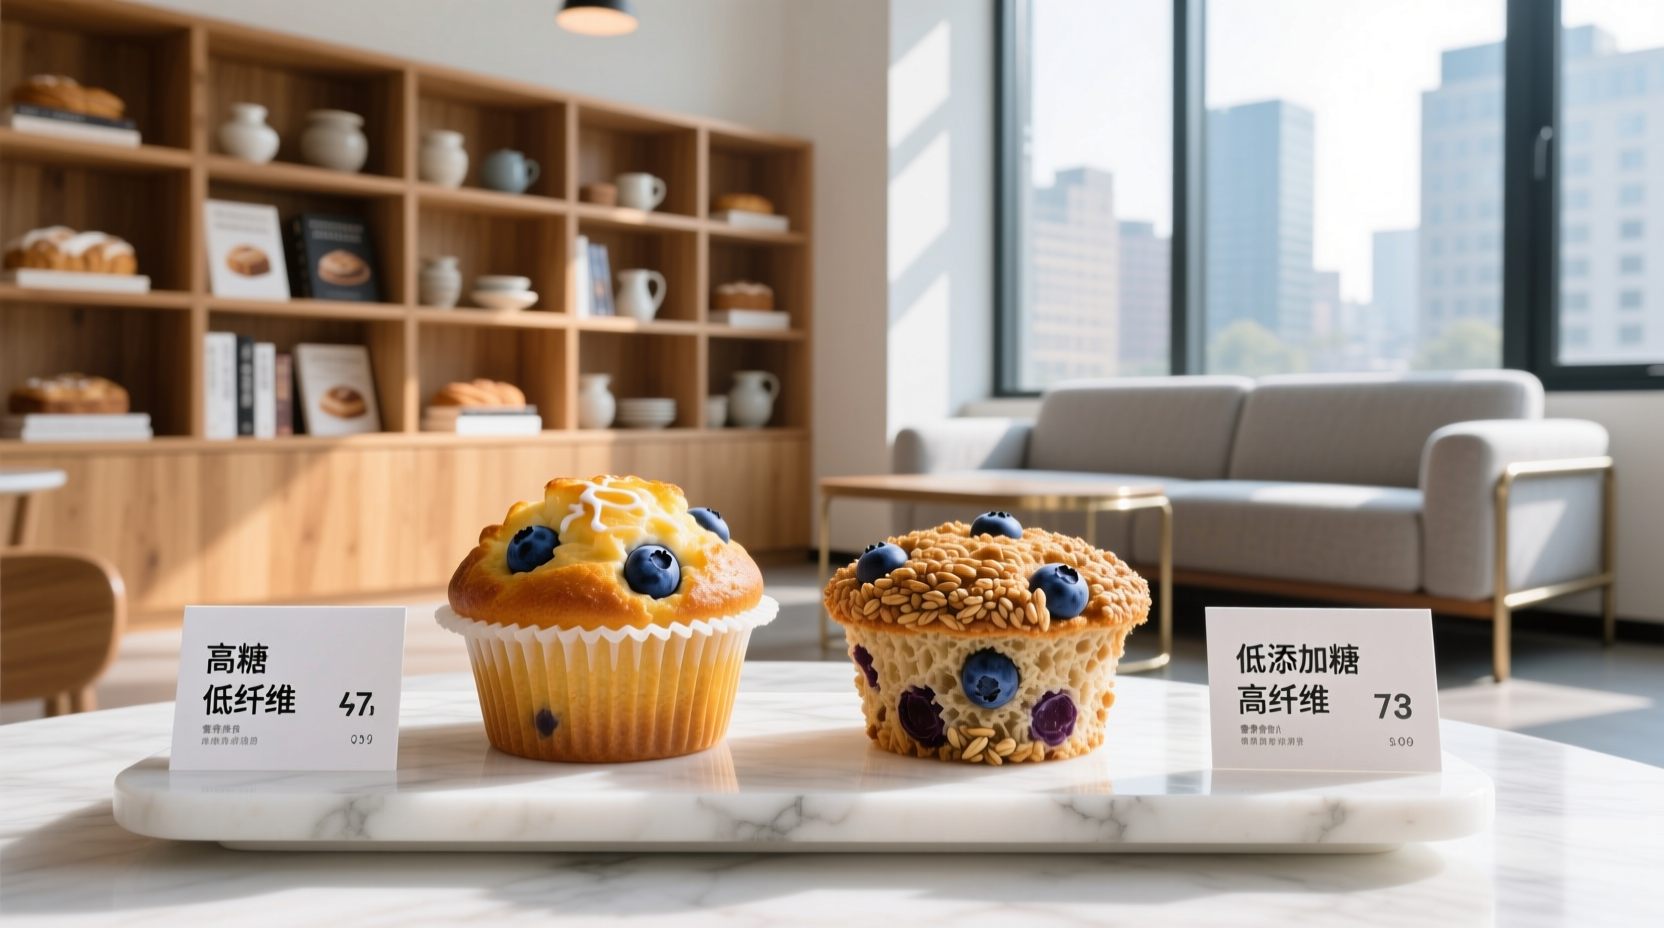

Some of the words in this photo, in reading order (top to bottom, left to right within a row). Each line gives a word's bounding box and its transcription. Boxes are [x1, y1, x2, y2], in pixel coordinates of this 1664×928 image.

[206, 642, 269, 675] 高糖
[1236, 643, 1360, 676] 低添加糖
[203, 684, 296, 716] 低纤维
[1237, 683, 1331, 716] 高纤维
[1373, 692, 1413, 720] 73
